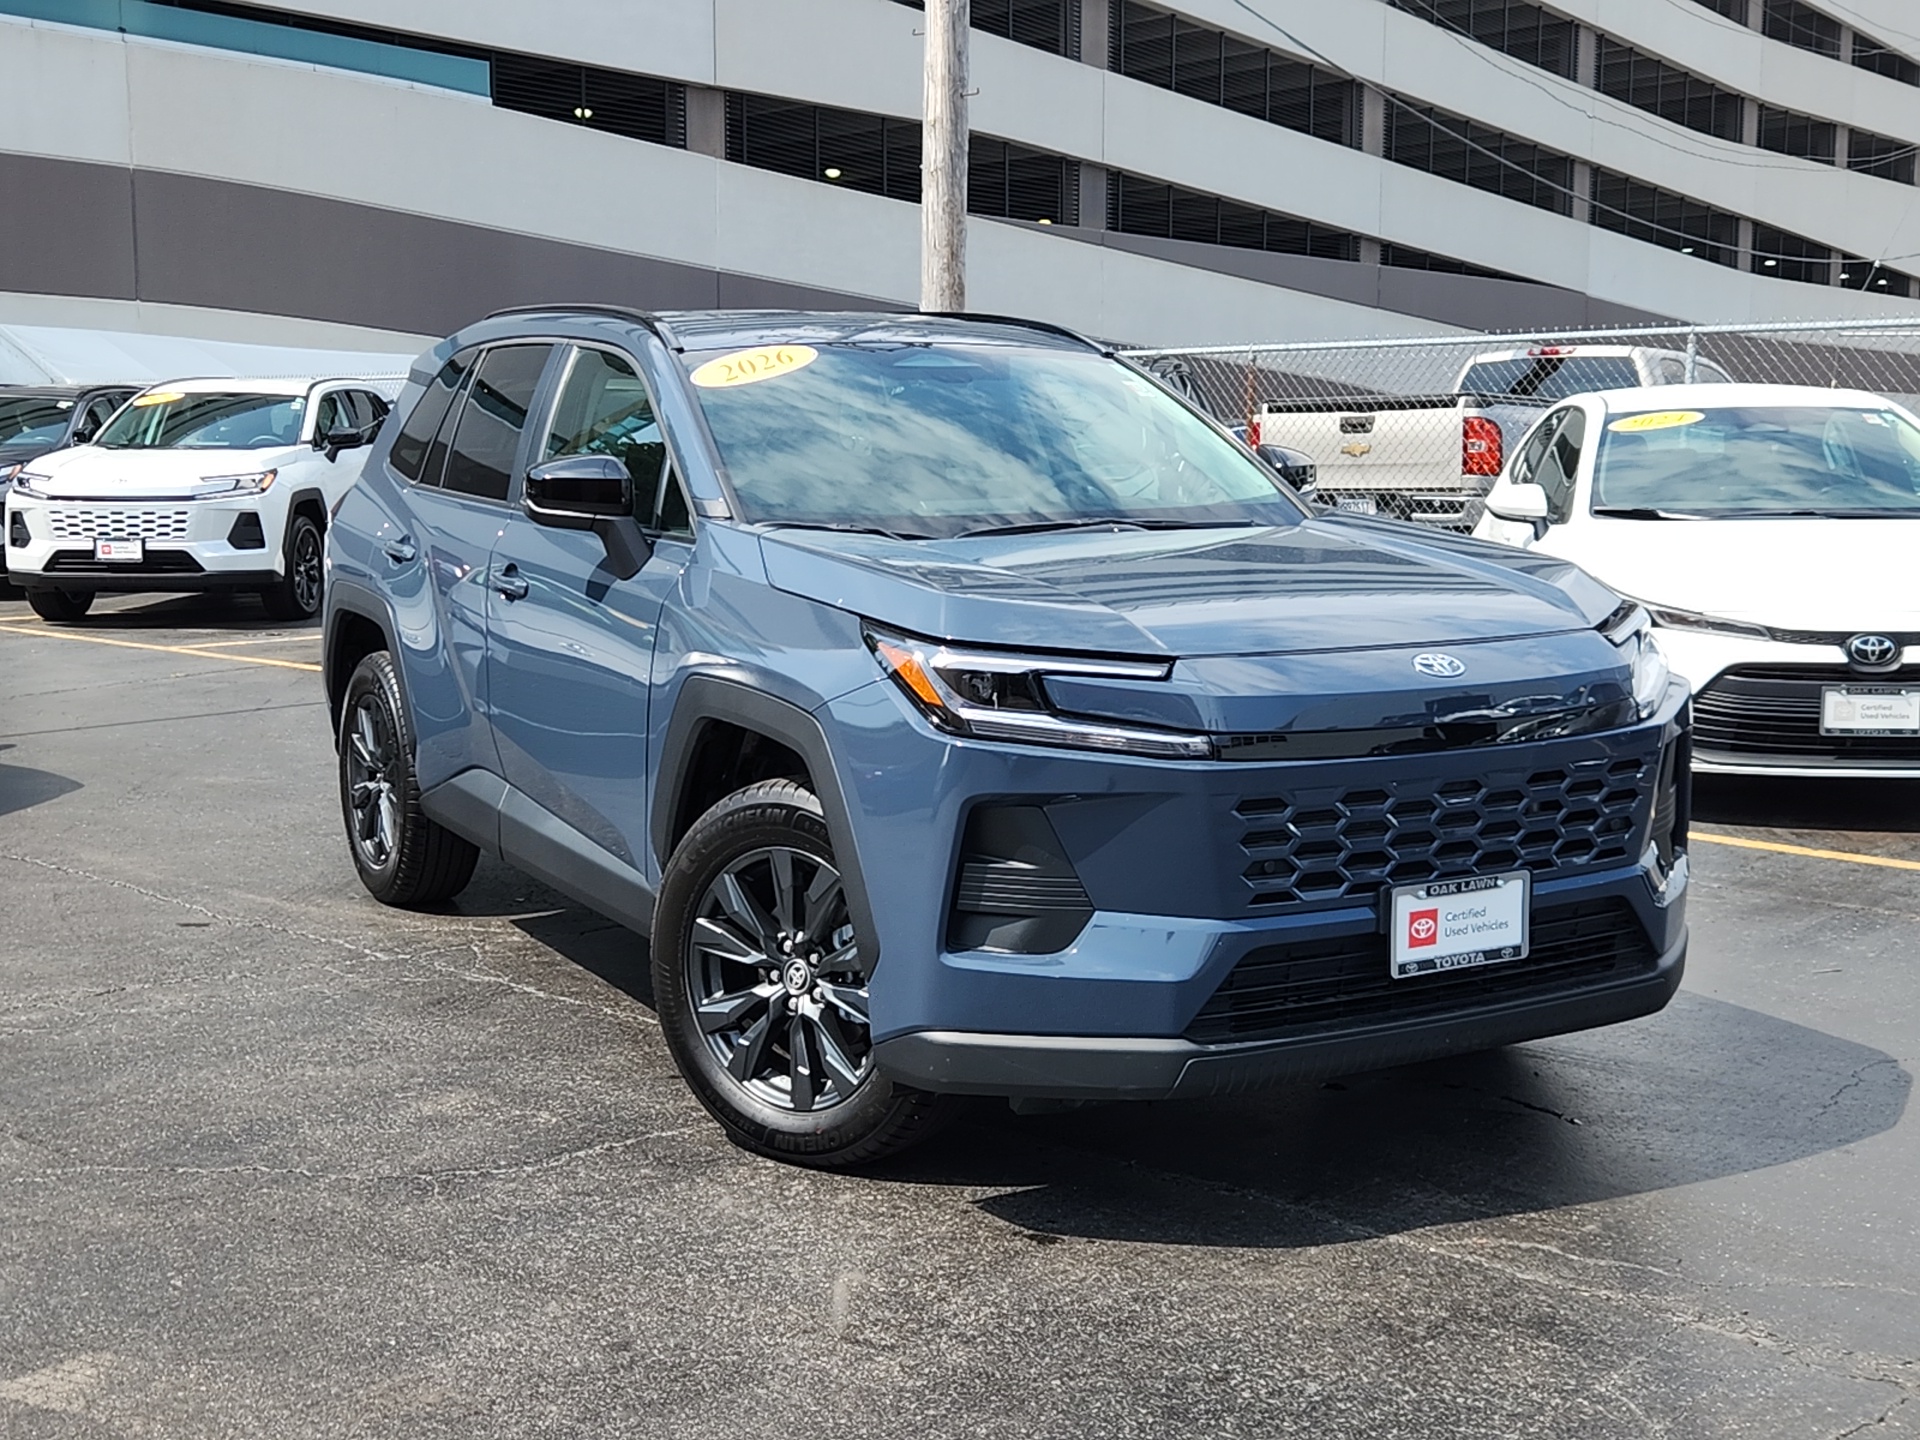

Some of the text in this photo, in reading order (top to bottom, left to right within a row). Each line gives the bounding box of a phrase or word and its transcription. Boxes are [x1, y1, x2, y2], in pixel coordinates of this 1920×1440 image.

[719, 349, 794, 383] 2026
[1860, 703, 1893, 712] Certified
[1860, 712, 1910, 720] Used Vehicles
[1429, 877, 1496, 896] OAK LAWN
[1444, 906, 1487, 922] Certified
[1444, 919, 1509, 938] Used Vehicles
[1434, 951, 1486, 969] TOYOTA
